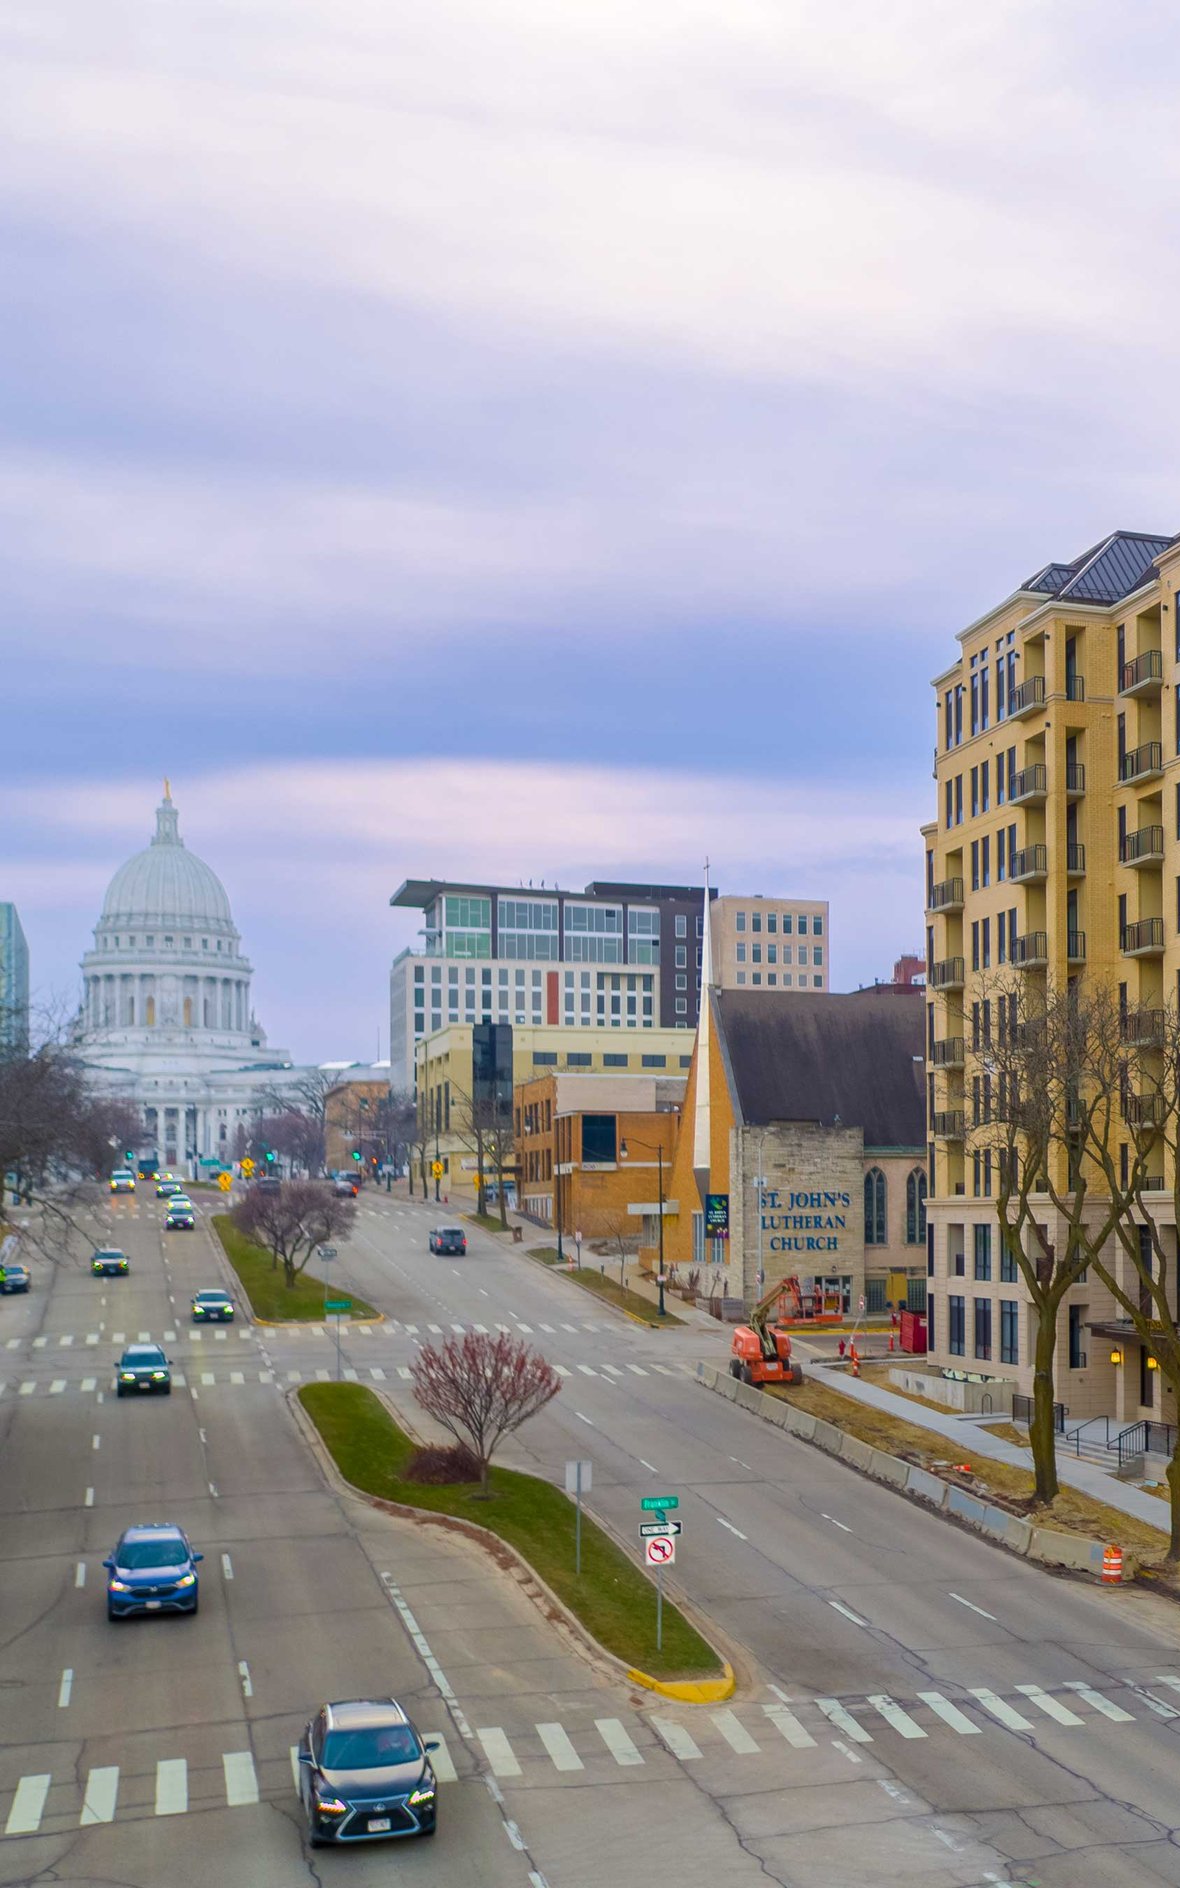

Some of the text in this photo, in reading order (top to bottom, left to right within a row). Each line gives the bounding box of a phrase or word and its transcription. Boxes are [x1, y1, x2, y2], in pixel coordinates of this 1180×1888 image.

[760, 1191, 851, 1211] ST. JOHN'S
[761, 1215, 846, 1230] LUTHERAN
[770, 1236, 838, 1251] CHURCH
